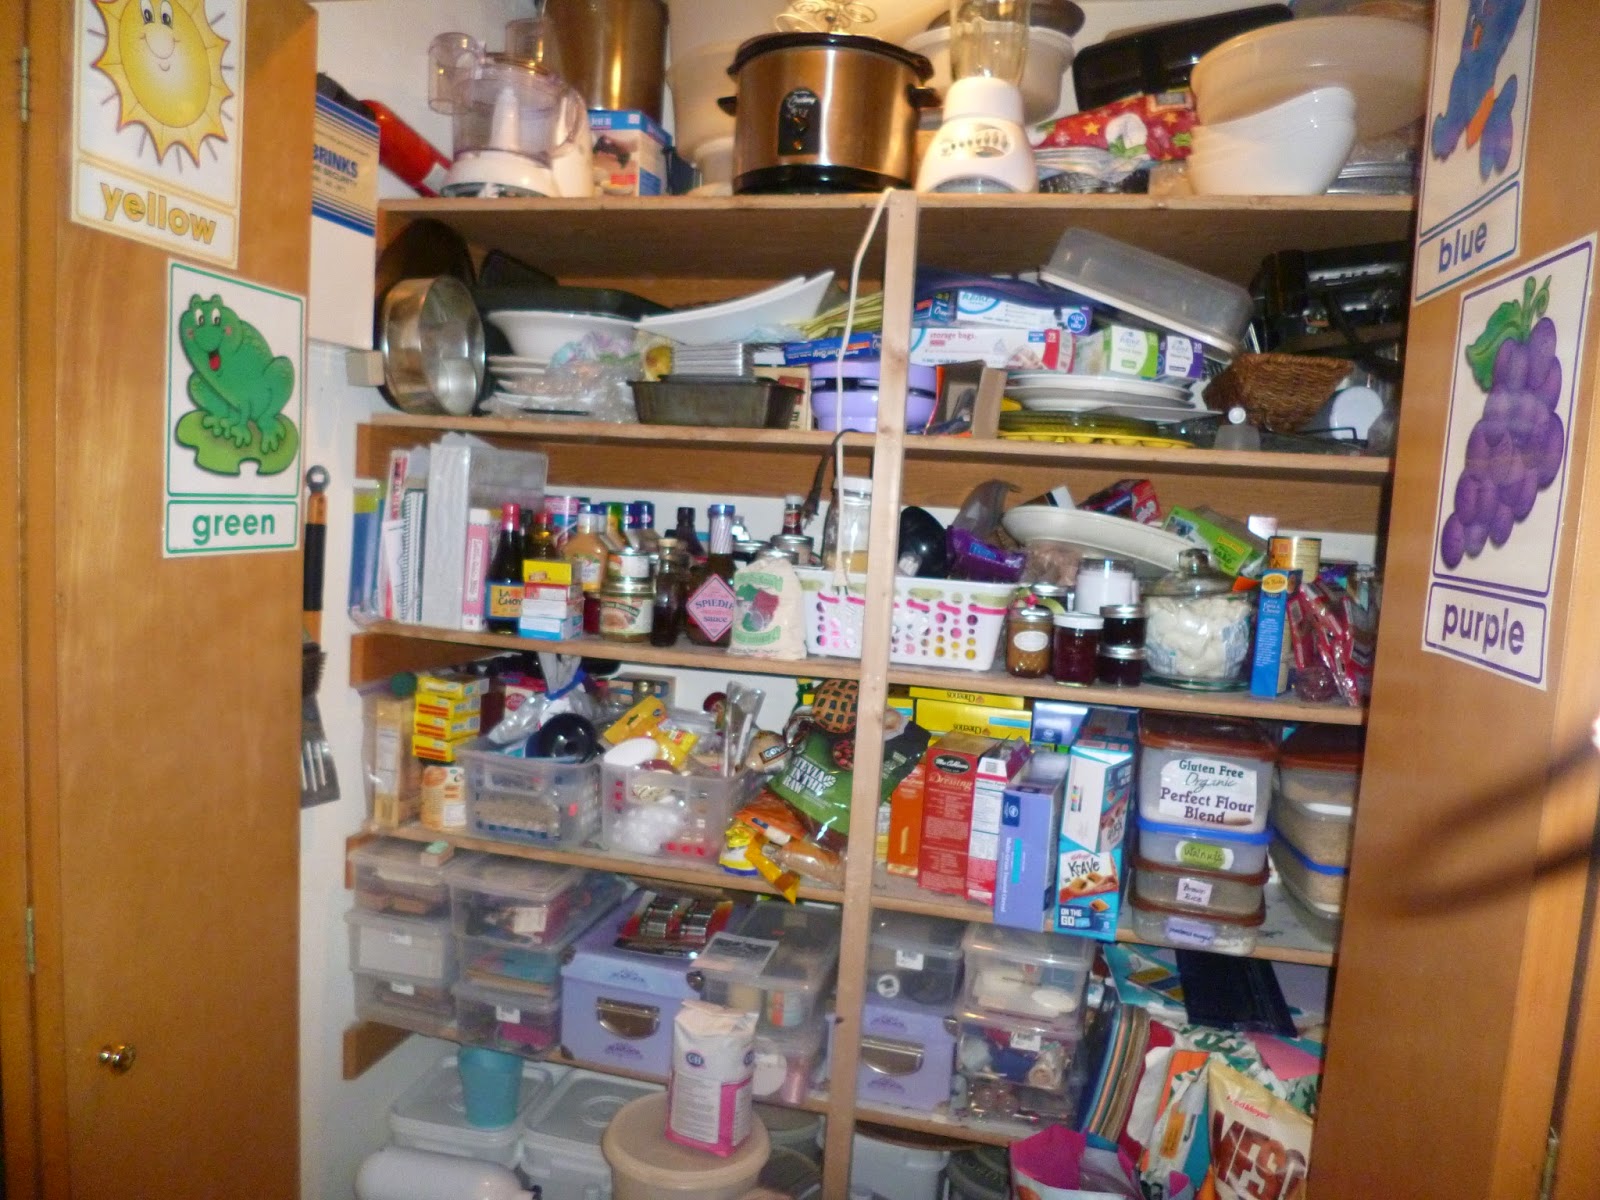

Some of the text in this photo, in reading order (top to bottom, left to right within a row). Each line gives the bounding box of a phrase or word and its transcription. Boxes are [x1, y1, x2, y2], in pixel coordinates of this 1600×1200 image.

[100, 182, 217, 245] yellow
[1438, 221, 1488, 273] blue
[930, 332, 975, 341] storage bags
[192, 514, 275, 546] green
[499, 588, 510, 597] LA
[1441, 604, 1525, 655] purple
[946, 691, 976, 704] Cheerios
[952, 723, 982, 735] Cheerios
[1179, 759, 1244, 778] Gluten Free
[928, 772, 973, 792] Dressing
[1185, 772, 1238, 793] Organic
[1160, 787, 1254, 813] Perfect Flour
[1184, 806, 1225, 824] Blend
[1060, 916, 1075, 926] GO
